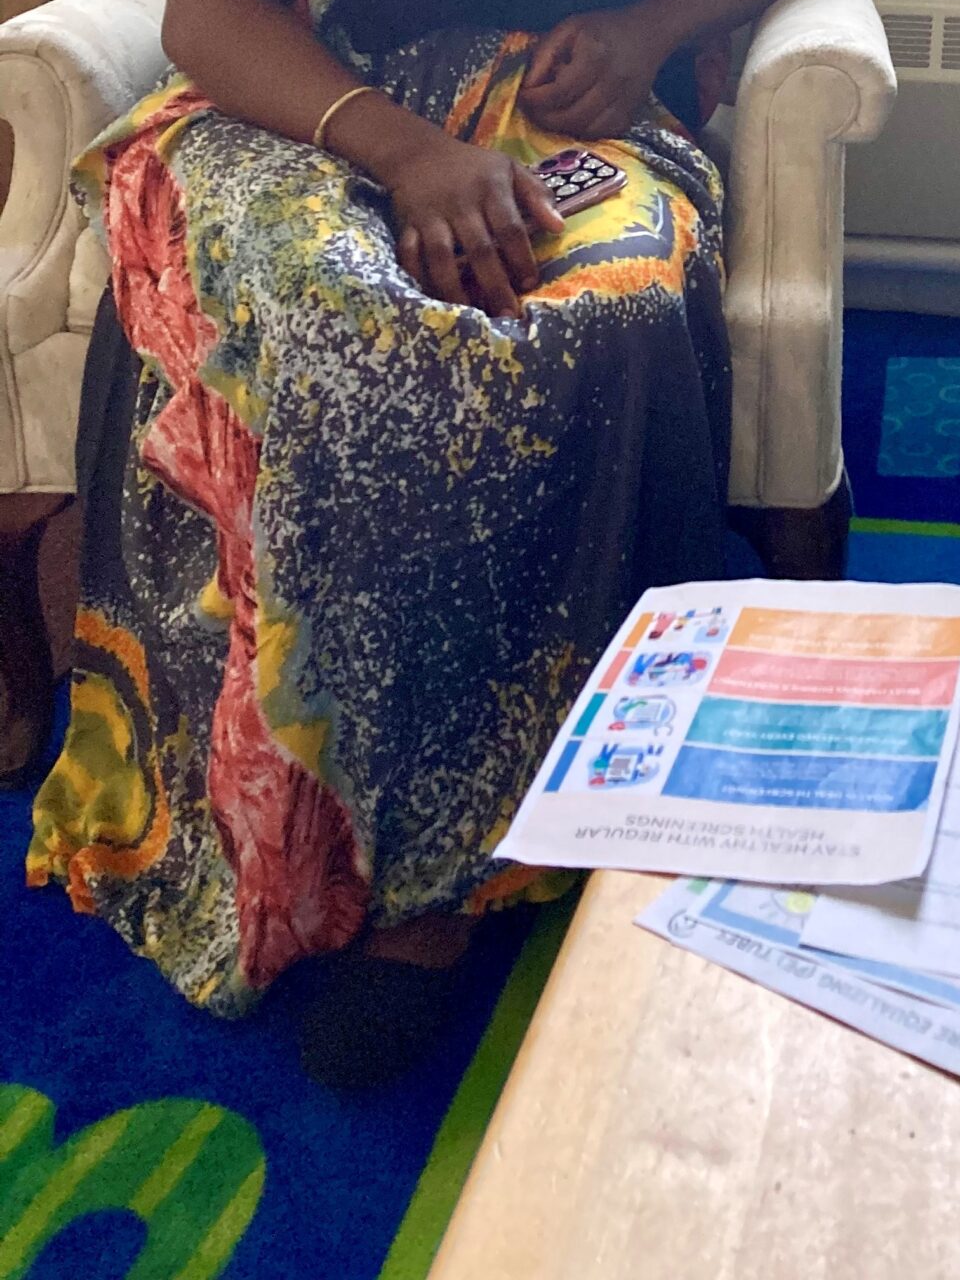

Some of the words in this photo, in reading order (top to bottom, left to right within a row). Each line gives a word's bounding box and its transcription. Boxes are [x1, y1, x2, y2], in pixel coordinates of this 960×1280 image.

[575, 823, 664, 843] REGULAR
[625, 814, 747, 838] SCREENINGS
[750, 824, 825, 841] HEALTH
[667, 832, 716, 849] WITH
[719, 837, 809, 856] HEALTHY
[812, 843, 861, 857] STAY
[714, 929, 774, 964] TUBES
[776, 957, 818, 985] (PE)
[817, 972, 933, 1036] EQUALIZING
